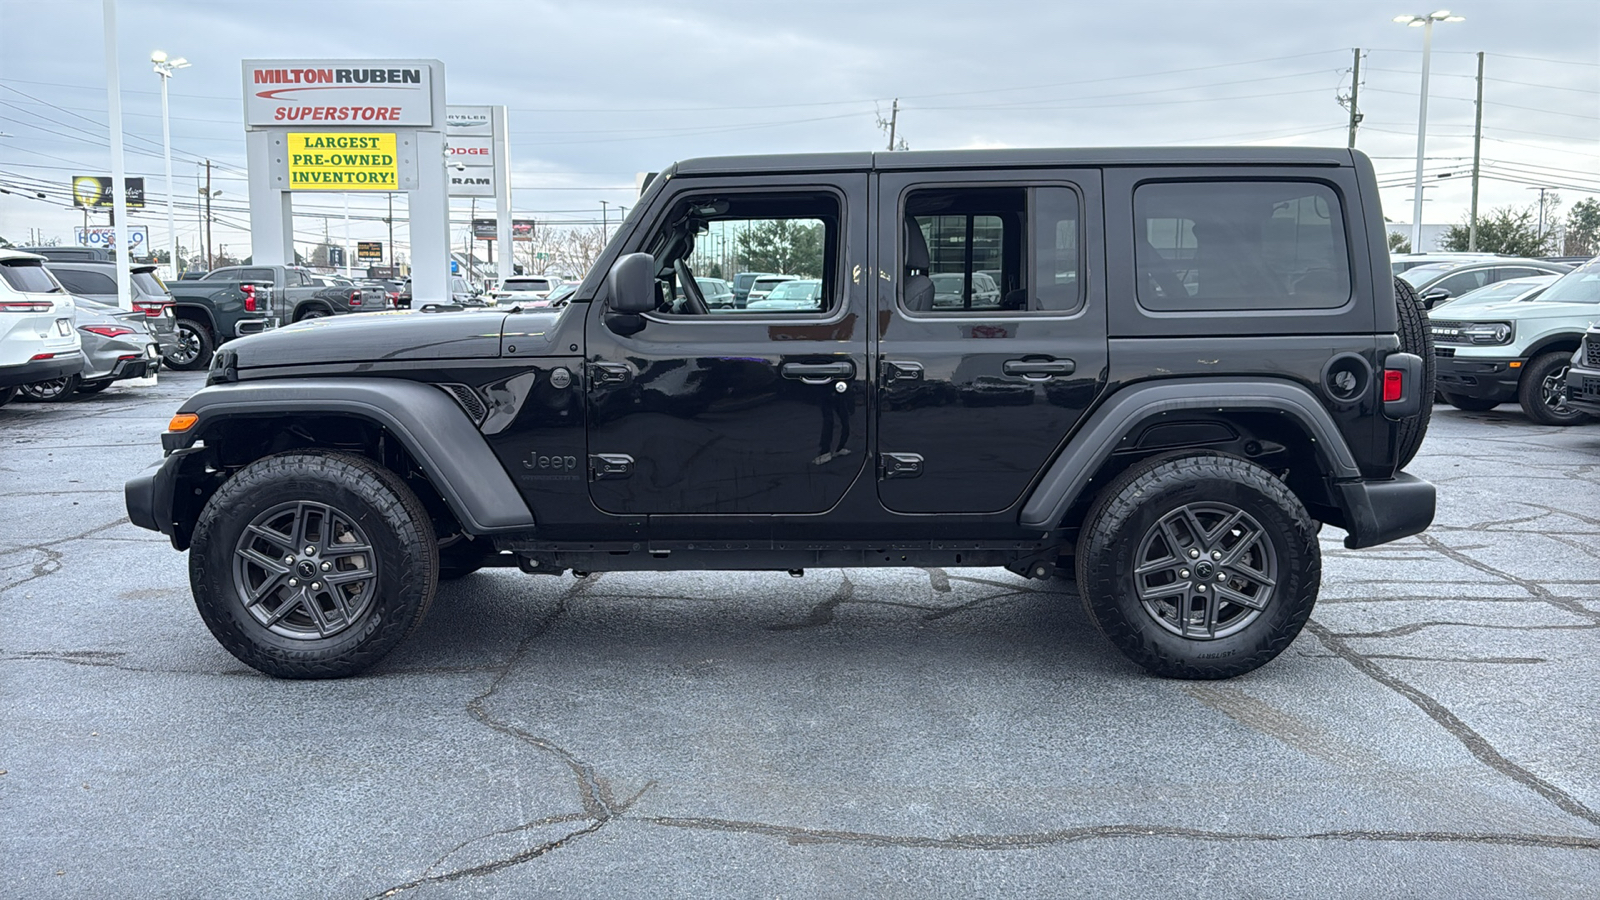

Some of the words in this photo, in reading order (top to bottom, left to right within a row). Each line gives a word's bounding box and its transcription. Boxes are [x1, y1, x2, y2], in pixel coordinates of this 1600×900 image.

[254, 69, 333, 84] MILTON
[335, 69, 420, 84] RUBEN
[274, 106, 402, 121] SUPERSTORE
[304, 137, 380, 149] LARGEST
[292, 154, 393, 166] PRE-OWNED
[292, 171, 395, 184] INVENTORY!
[522, 451, 577, 473] Jeep
